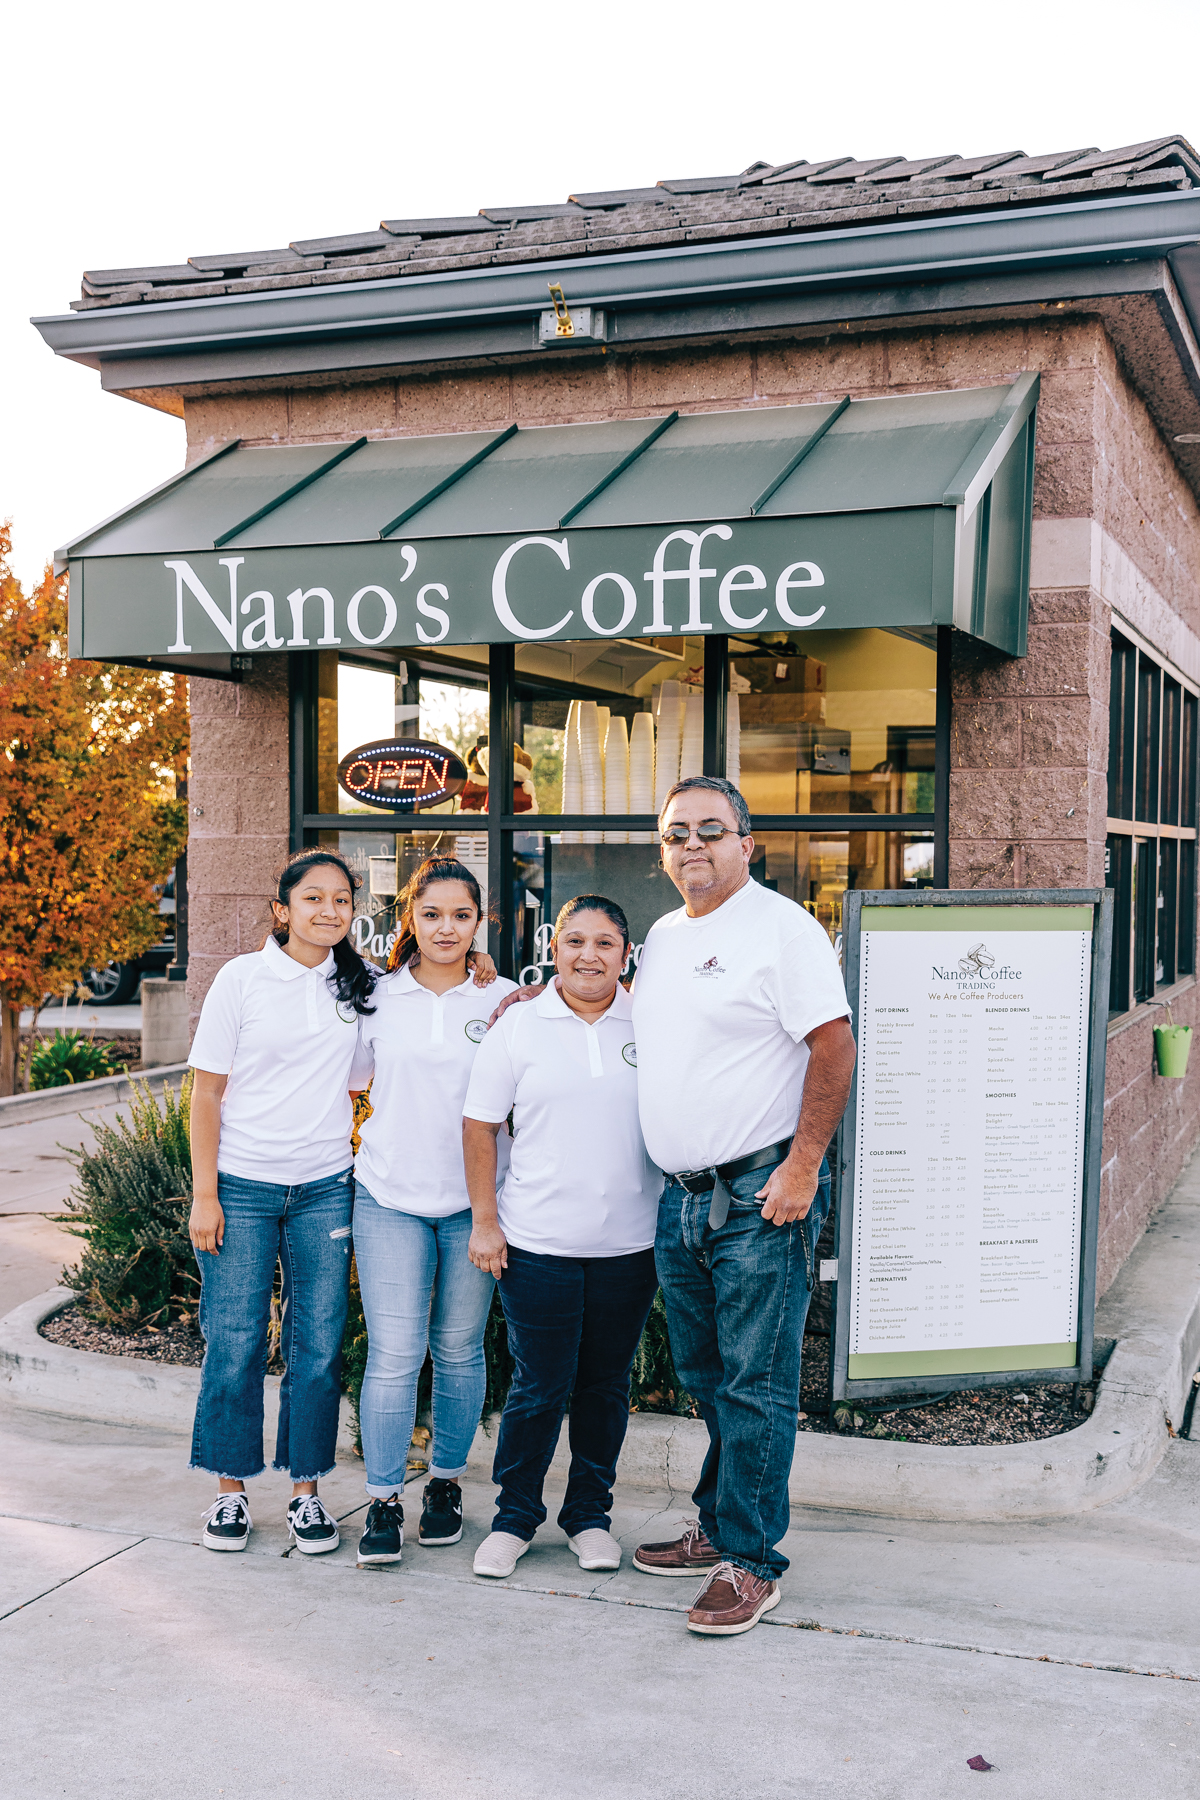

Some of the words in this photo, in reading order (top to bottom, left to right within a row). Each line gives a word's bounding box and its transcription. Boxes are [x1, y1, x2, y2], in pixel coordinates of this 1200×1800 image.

[164, 545, 450, 654] Nano's
[492, 524, 826, 640] Coffee
[345, 759, 449, 790] OPEN
[351, 915, 402, 958] Past
[931, 966, 975, 980] Nano's
[979, 965, 1022, 980] Coffee
[928, 992, 941, 1000] We
[943, 992, 957, 1000] Are
[959, 992, 985, 1000] Coffee
[987, 991, 1024, 1000] Producers
[956, 982, 996, 990] TRADING
